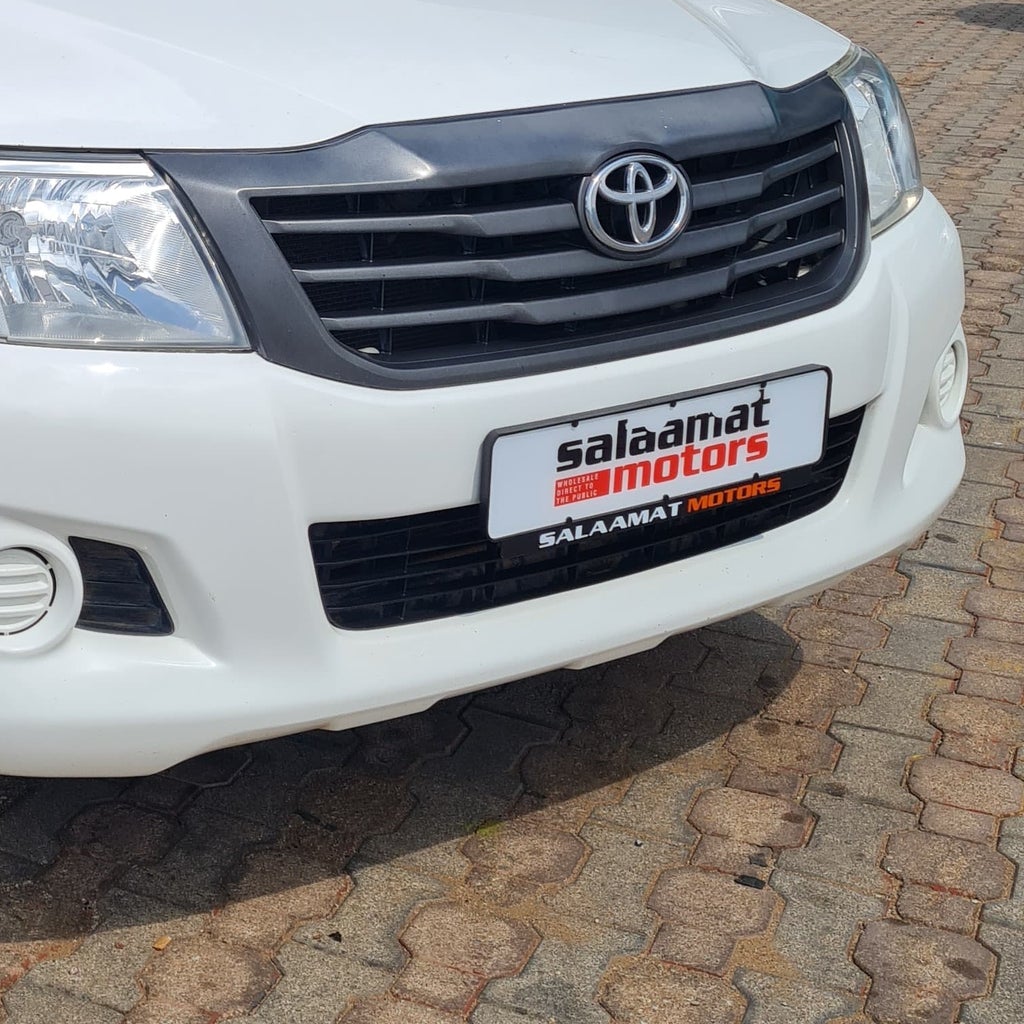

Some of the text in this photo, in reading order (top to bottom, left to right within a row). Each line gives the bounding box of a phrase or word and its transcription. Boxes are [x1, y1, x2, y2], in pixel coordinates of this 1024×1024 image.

[556, 387, 770, 473] salaamat
[557, 473, 599, 488] WHOLESALE
[612, 432, 769, 493] motors
[556, 482, 594, 497] DIRECT TO
[556, 489, 598, 505] THE PUBLIC
[538, 477, 782, 549] SALAAMAT MOTORS
